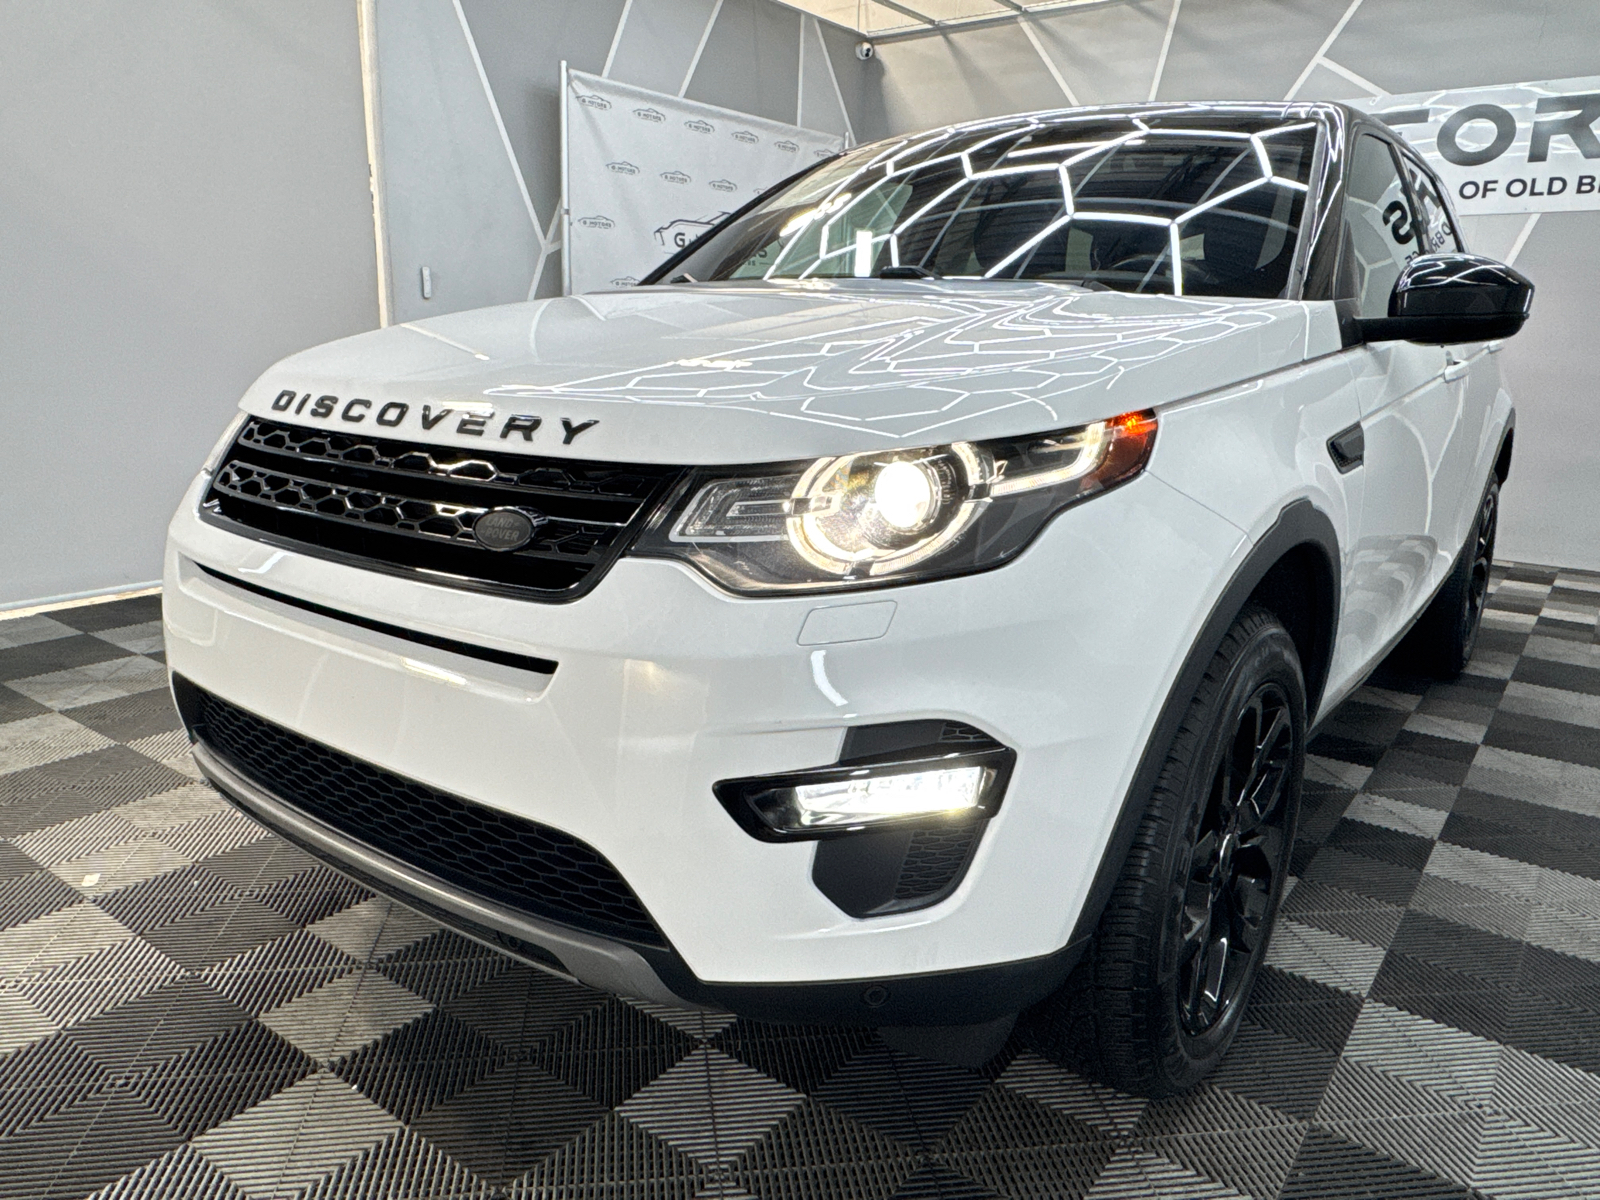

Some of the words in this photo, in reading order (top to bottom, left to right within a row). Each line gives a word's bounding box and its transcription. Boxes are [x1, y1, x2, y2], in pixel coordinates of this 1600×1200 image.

[1459, 180, 1498, 199] OF
[1505, 177, 1567, 197] OLD
[1576, 175, 1600, 194] B
[271, 389, 600, 445] DISCOVERY
[486, 517, 514, 527] LAND
[485, 527, 520, 541] ROVER
